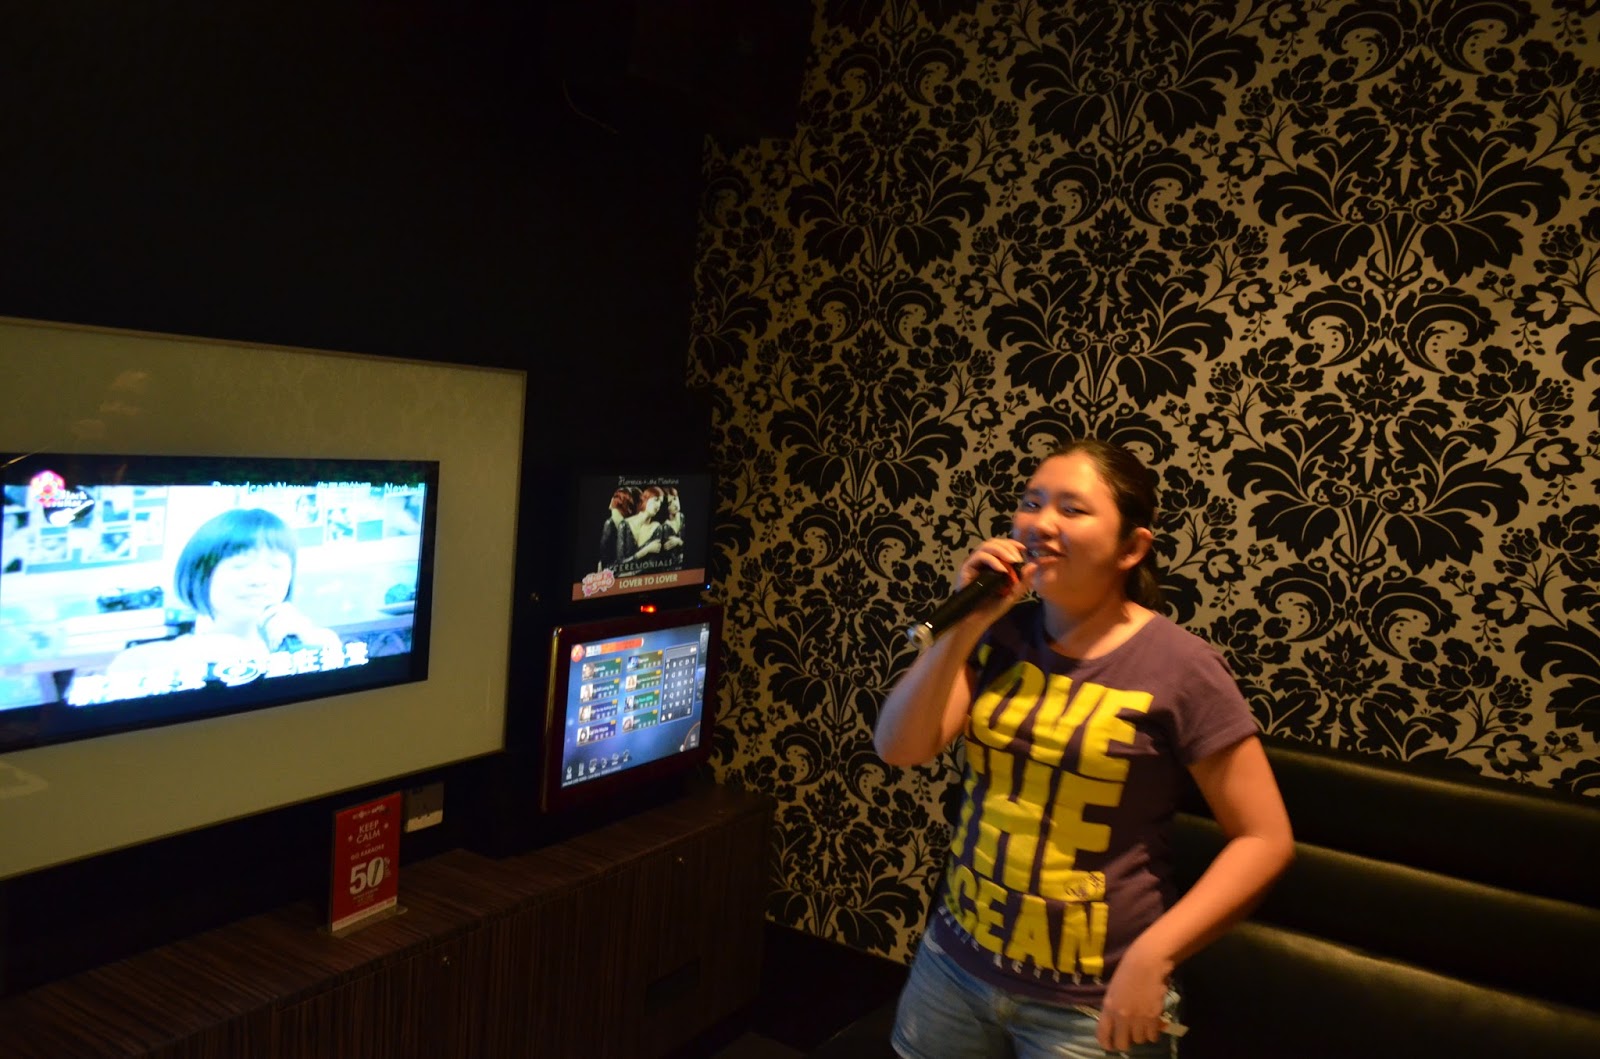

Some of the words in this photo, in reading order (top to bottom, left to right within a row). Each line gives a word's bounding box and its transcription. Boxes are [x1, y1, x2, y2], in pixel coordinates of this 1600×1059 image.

[612, 558, 673, 572] CEREMONIALS
[619, 577, 643, 589] LOVER
[644, 576, 655, 586] TO
[656, 573, 678, 585] LOVER
[968, 645, 1154, 781] OVE
[359, 819, 379, 834] KEEP
[951, 740, 1125, 902] THE
[356, 829, 381, 844] CALM
